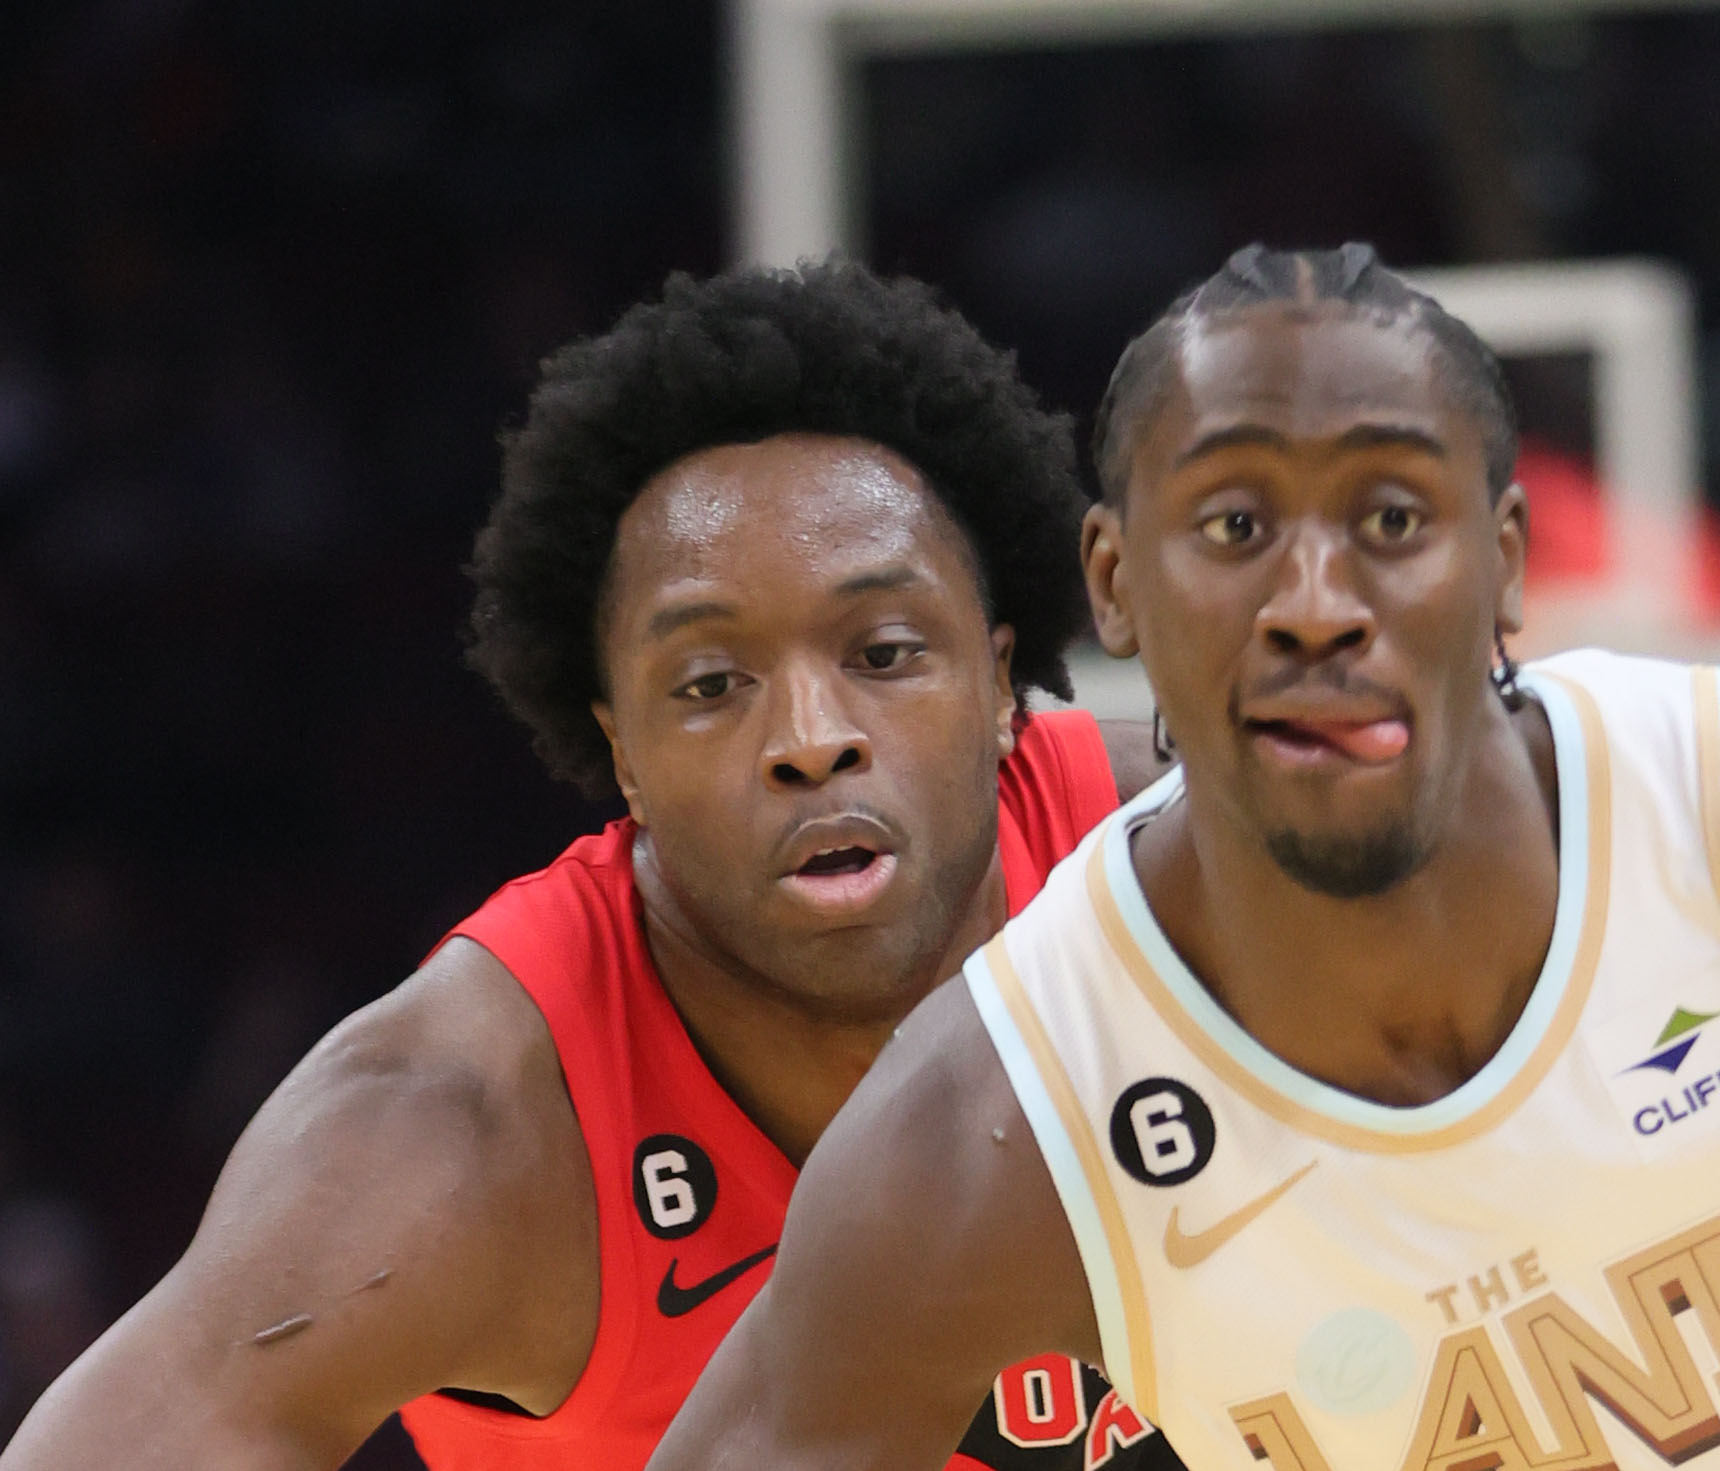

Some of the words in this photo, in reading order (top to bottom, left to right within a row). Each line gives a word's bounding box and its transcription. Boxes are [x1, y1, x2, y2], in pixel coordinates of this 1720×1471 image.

[1130, 1091, 1198, 1178] 6
[642, 1148, 699, 1229] 6
[1426, 1248, 1549, 1324] THE
